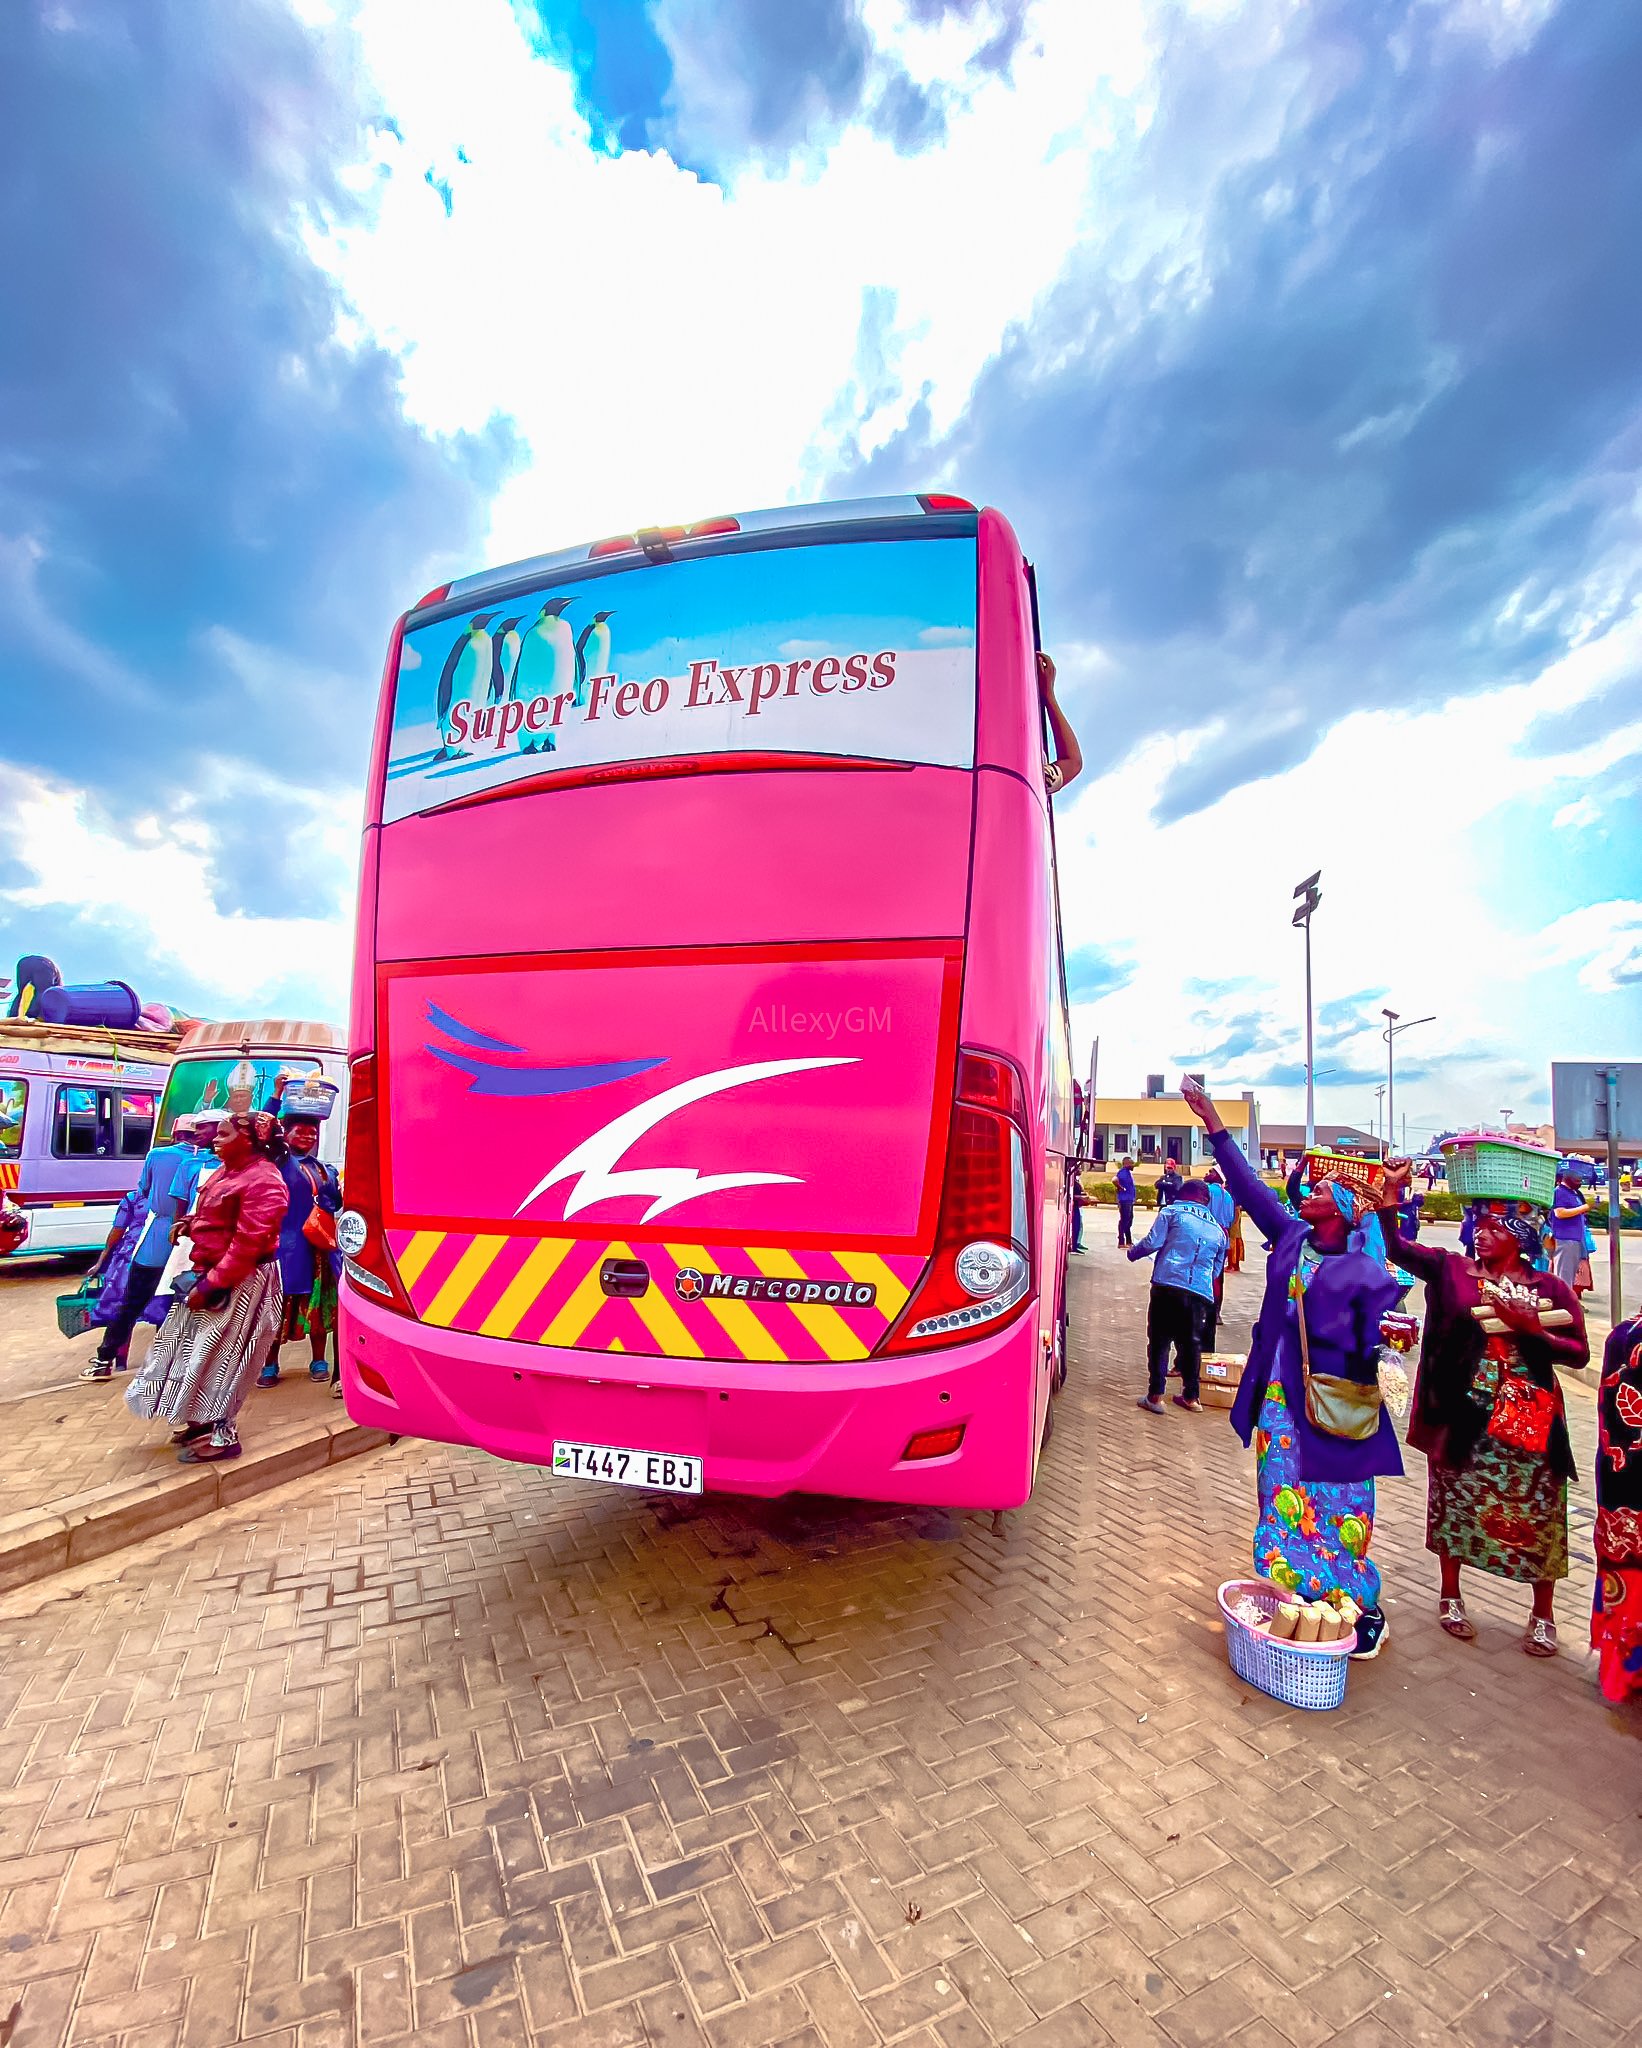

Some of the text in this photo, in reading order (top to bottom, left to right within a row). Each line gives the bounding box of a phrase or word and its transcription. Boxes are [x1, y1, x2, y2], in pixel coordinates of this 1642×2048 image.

[446, 650, 898, 750] Super Feo Express
[709, 1274, 873, 1304] Marcopolo
[570, 1448, 693, 1489] T447 EBJ
